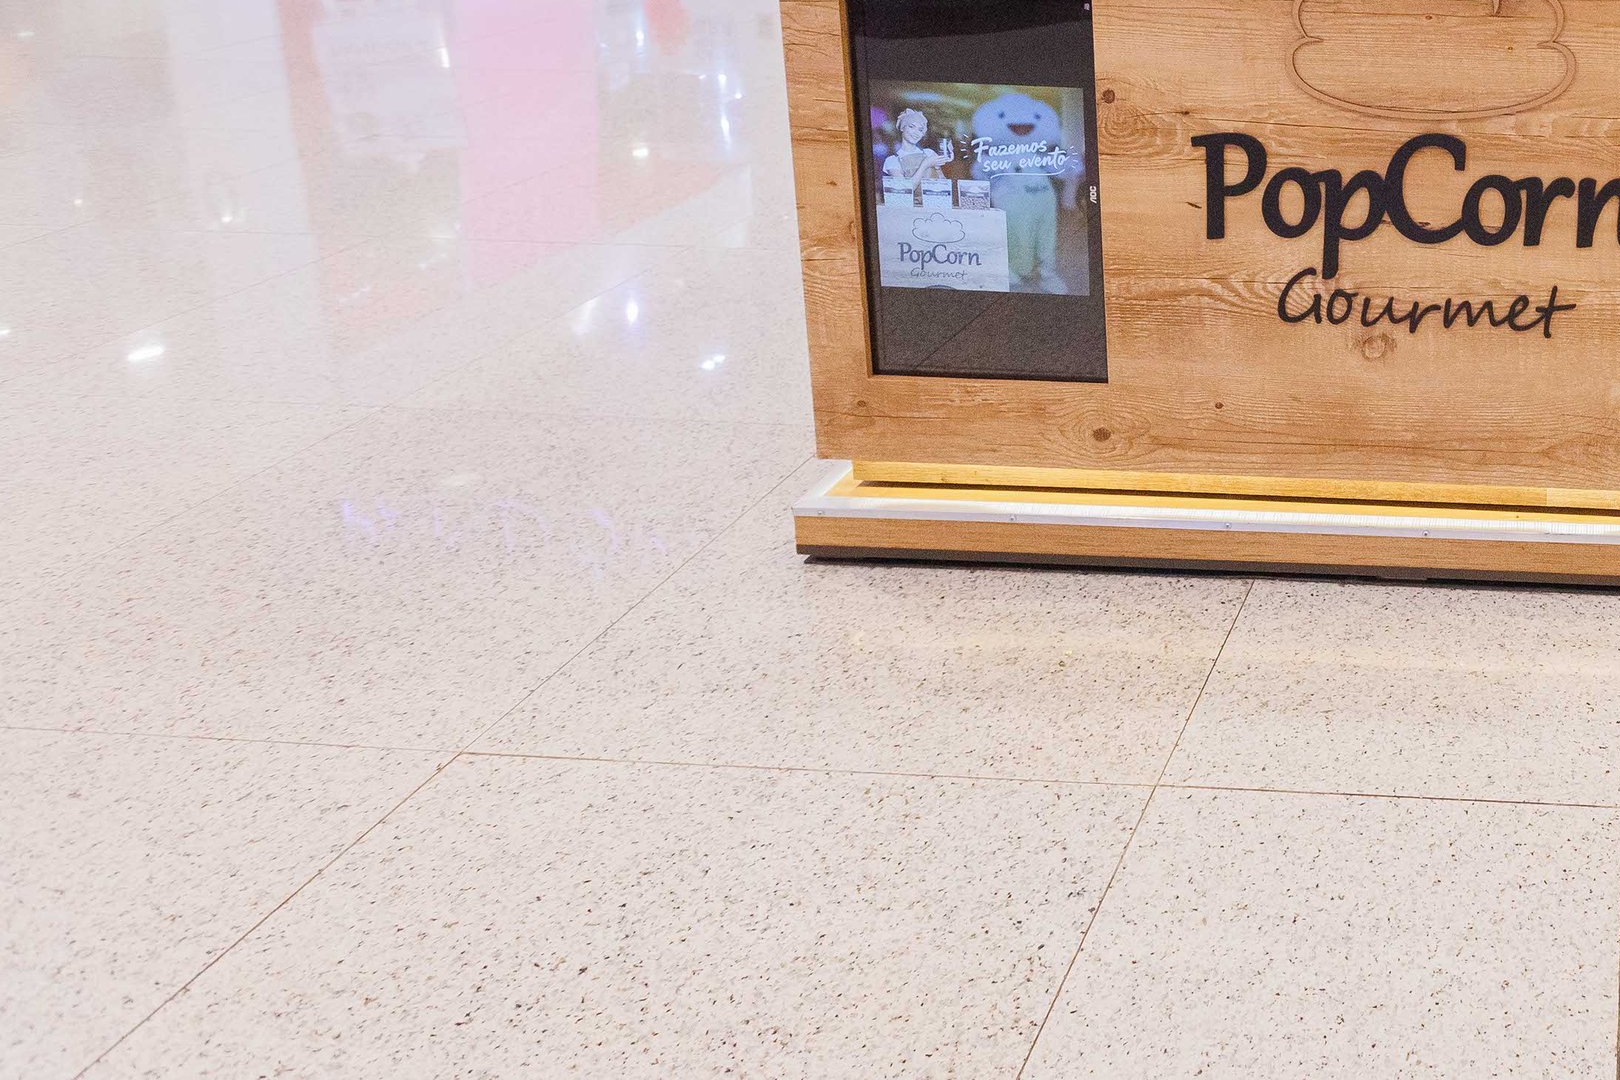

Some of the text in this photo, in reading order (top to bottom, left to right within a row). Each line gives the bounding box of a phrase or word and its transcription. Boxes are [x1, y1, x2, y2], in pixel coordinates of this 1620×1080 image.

[971, 136, 1049, 163] Fazemos
[982, 146, 1071, 172] seu evento
[898, 241, 982, 270] PopCorn
[909, 268, 969, 281] Gourmet
[1276, 266, 1577, 339] Gourmet
